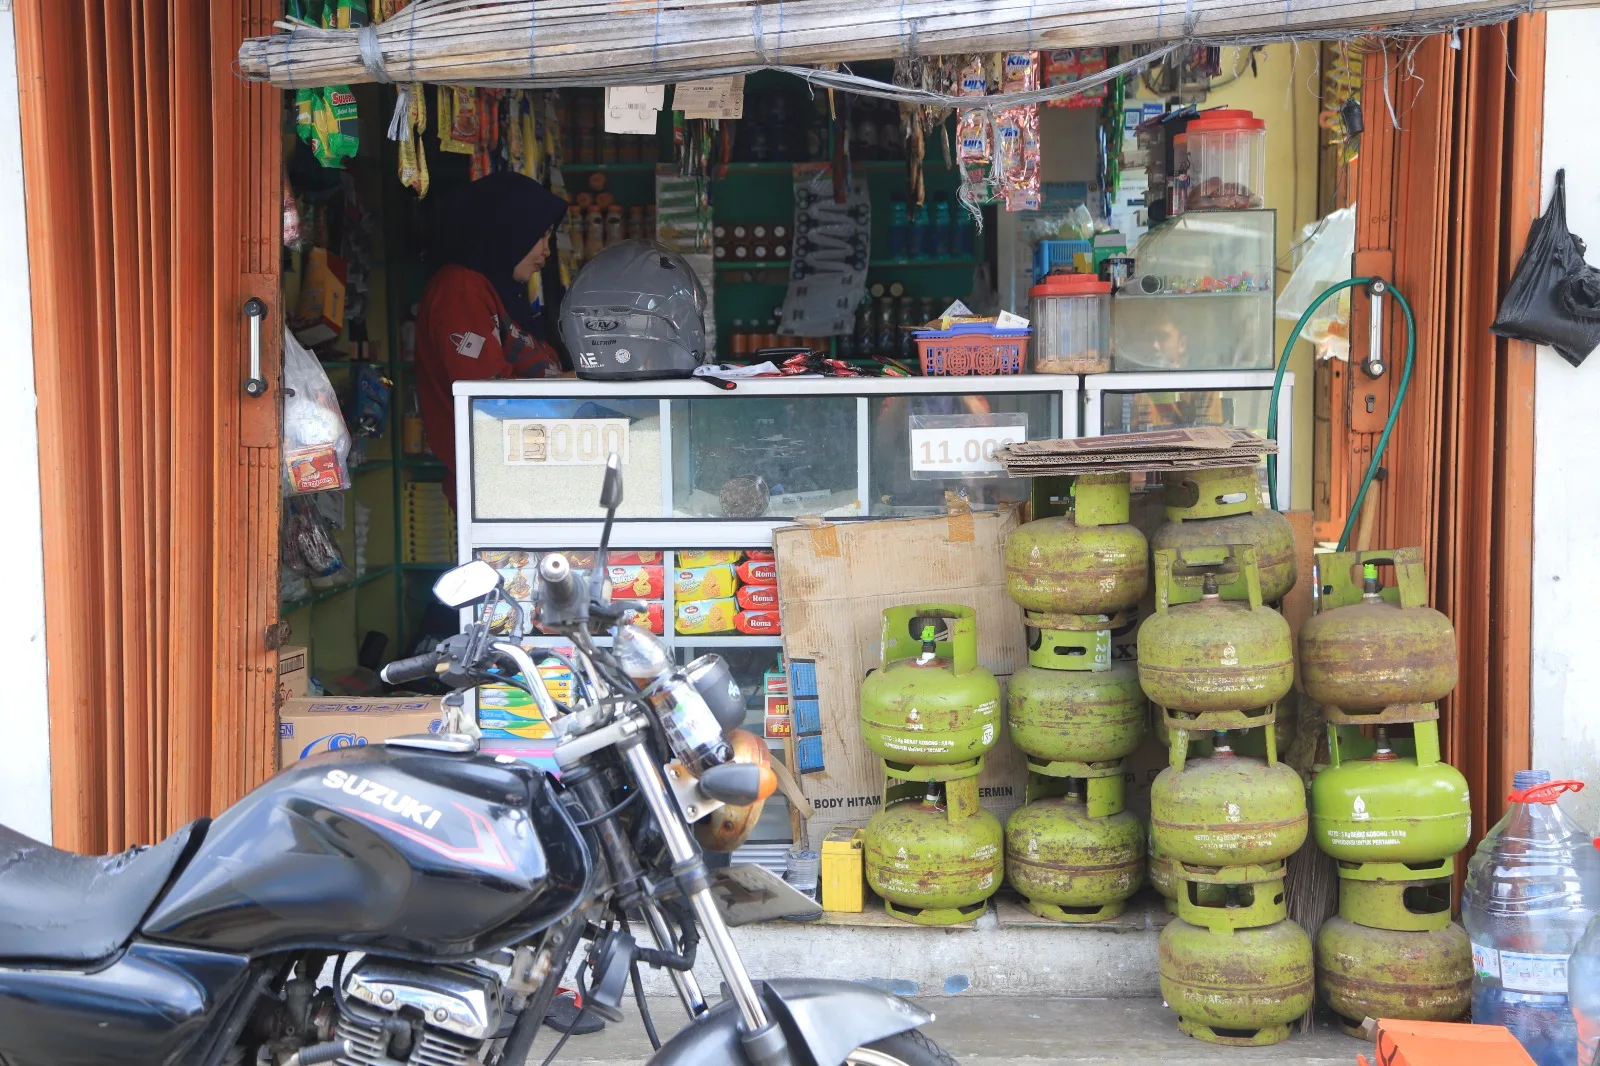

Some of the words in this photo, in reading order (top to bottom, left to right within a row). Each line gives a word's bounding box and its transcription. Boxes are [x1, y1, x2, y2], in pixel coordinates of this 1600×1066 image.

[1006, 55, 1030, 66] Klin
[920, 438, 1015, 464] 11.00
[753, 594, 773, 602] Roma
[751, 619, 772, 627] Roma
[775, 705, 789, 713] SUP
[772, 725, 790, 733] PER
[322, 770, 442, 830] SUZUKI
[814, 798, 844, 809] BODY
[847, 795, 881, 807] HITAM
[978, 786, 1013, 798] ERMIN
